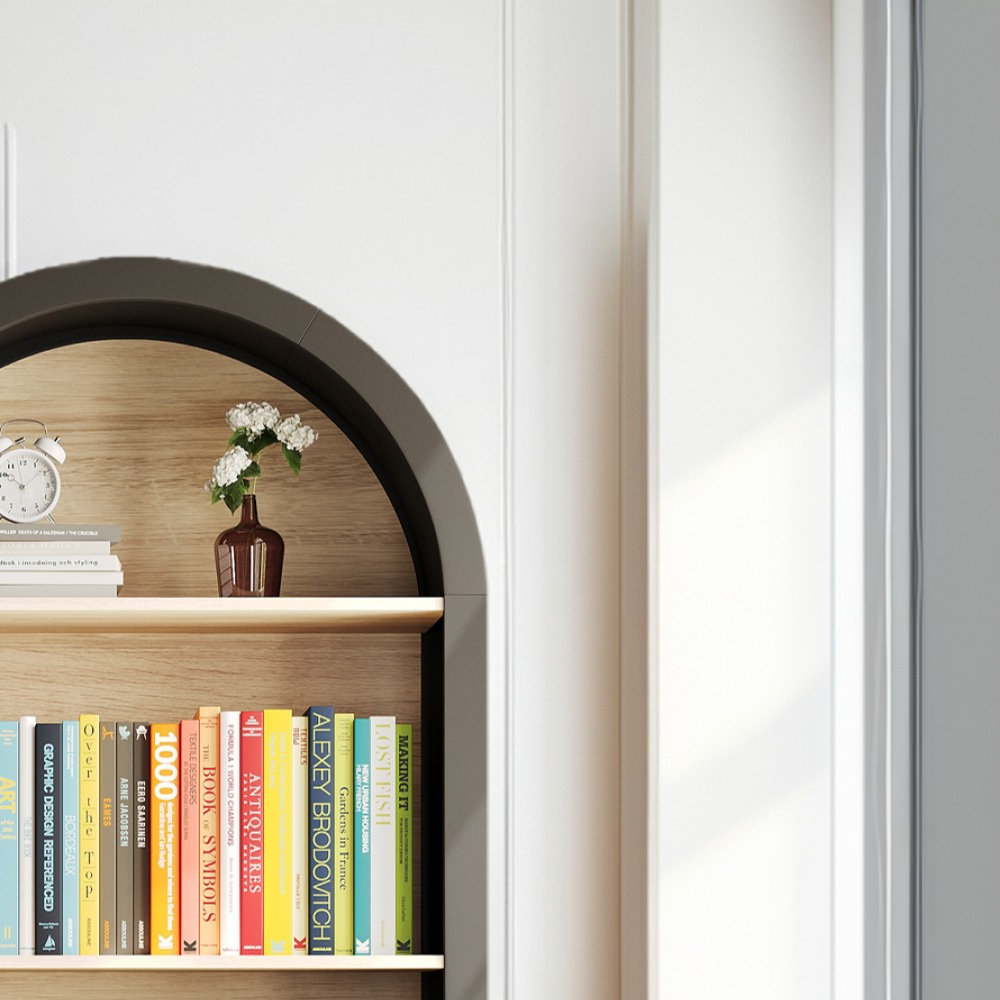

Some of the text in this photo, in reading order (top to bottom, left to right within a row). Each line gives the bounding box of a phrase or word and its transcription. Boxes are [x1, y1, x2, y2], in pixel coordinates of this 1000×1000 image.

[43, 743, 54, 793] GRAPHIC
[84, 724, 94, 778] Over
[154, 731, 178, 800] 1000
[189, 733, 197, 805] TEXTILE DESIGNERS
[313, 712, 331, 796] ALEXEY
[375, 723, 391, 826] LOST FISH
[398, 735, 408, 811] MAKING IT
[0, 776, 16, 814] ART
[43, 796, 54, 836] DESIGN
[103, 798, 111, 827] EAMES
[120, 778, 128, 847] ARNE JACOBSEN
[137, 781, 146, 848] EERO SAARINEN
[202, 766, 217, 816] BOOK
[202, 820, 209, 831] OF
[361, 764, 369, 853] NEW URBAN HOUSING
[65, 815, 76, 876] BORDEAUX
[244, 773, 261, 893] ANTIQUAIRES
[339, 786, 349, 890] Gardens in France
[43, 840, 54, 912] REFERENCED
[84, 852, 94, 898] Top
[202, 835, 217, 922] SYMBOLS
[313, 803, 331, 940] BRODOVITCH
